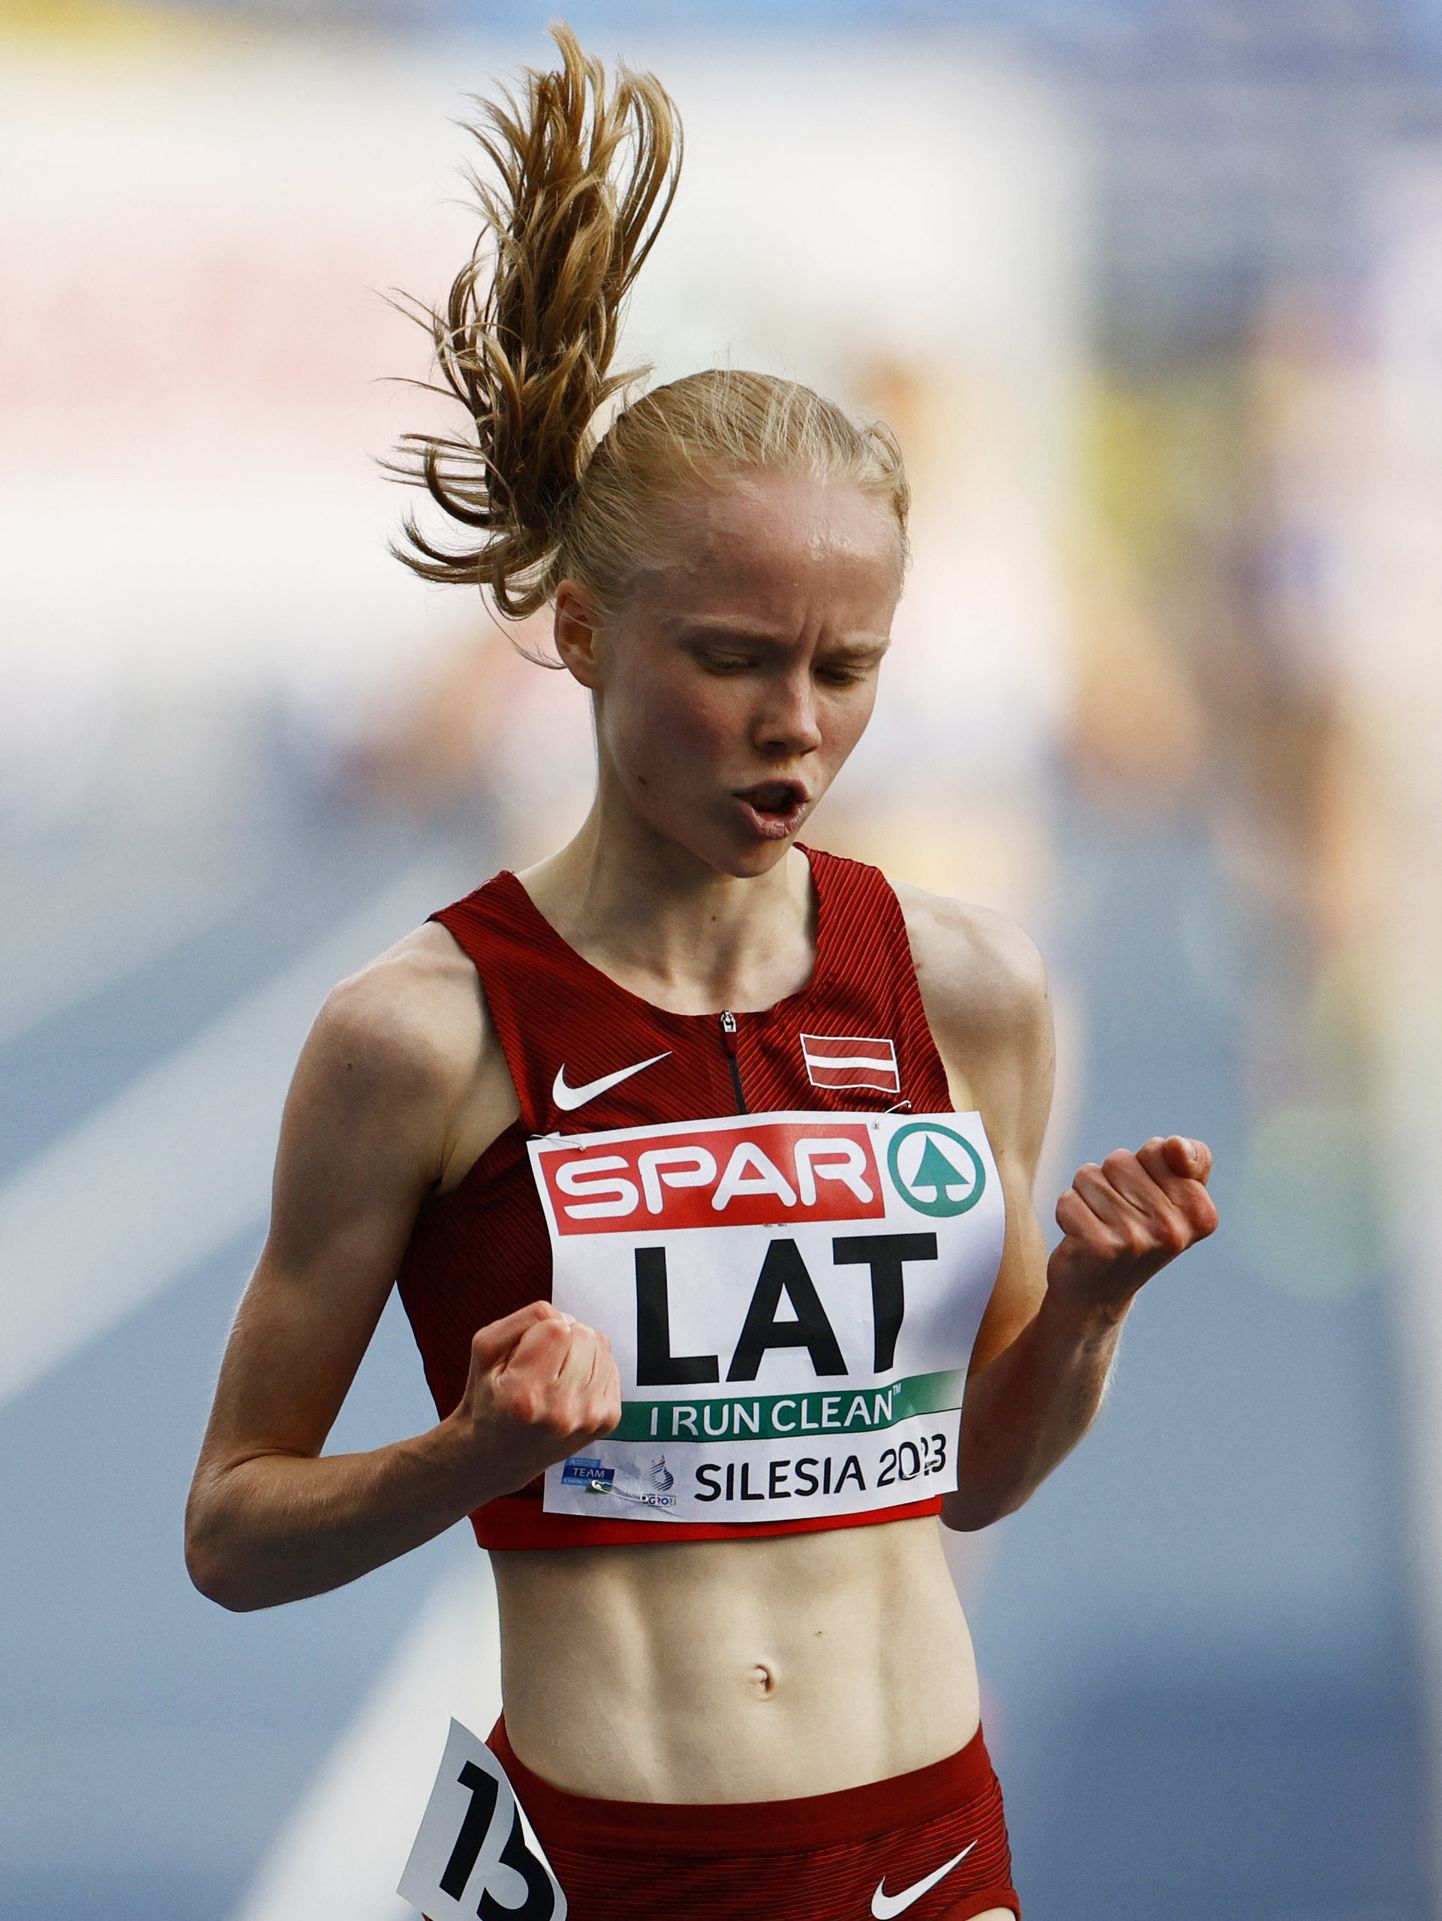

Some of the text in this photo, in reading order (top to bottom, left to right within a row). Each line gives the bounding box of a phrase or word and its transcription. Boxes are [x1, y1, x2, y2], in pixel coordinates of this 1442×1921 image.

[555, 1137, 874, 1220] SPAR
[634, 1232, 938, 1386] LAT
[650, 1406, 659, 1436] I
[671, 1402, 760, 1436] RUN
[571, 1467, 605, 1479] TEAM
[694, 1455, 867, 1502] SILESIA
